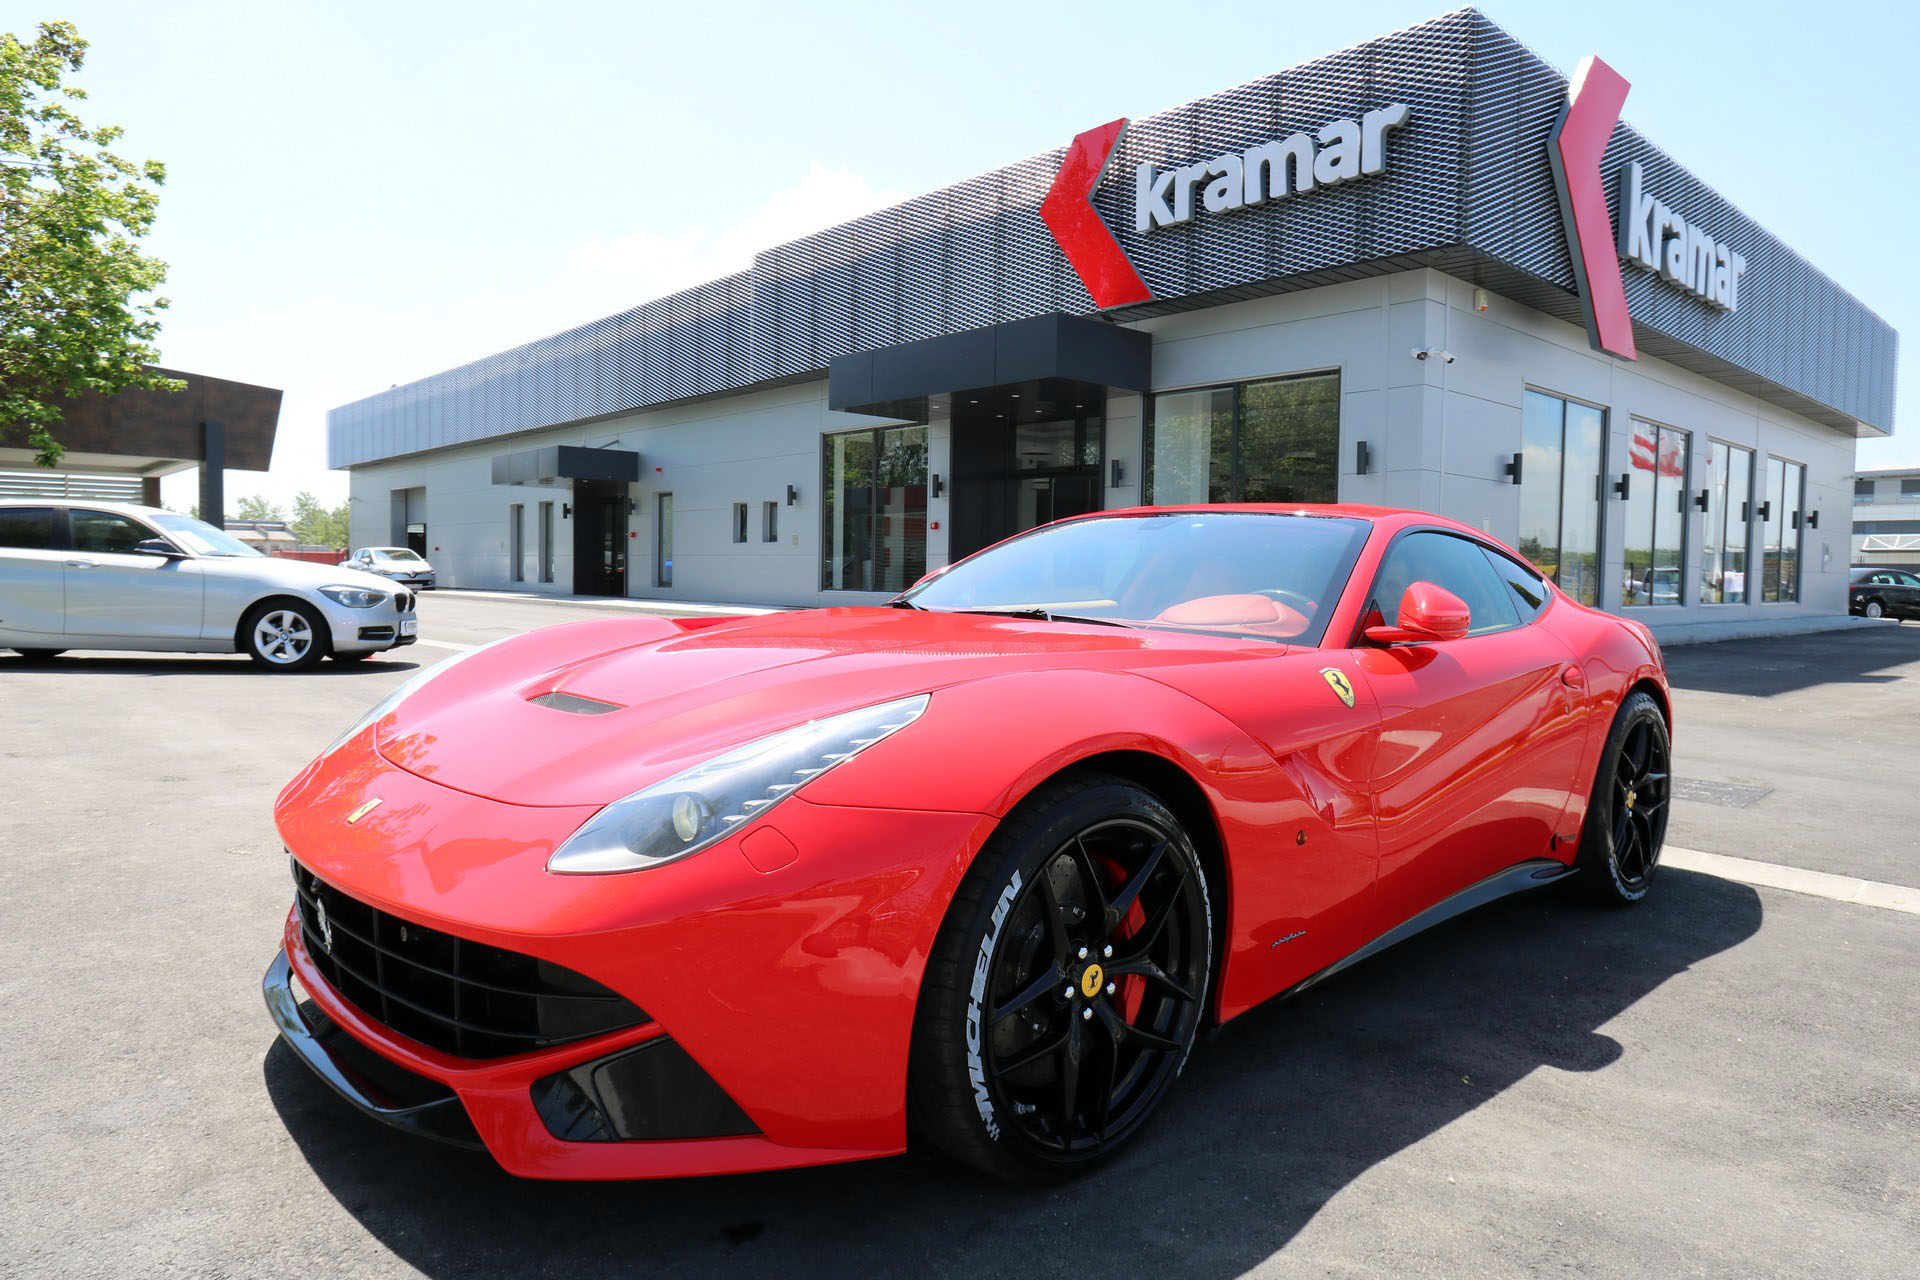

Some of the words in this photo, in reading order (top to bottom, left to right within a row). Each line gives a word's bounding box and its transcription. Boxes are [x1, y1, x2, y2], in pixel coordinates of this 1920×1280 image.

[1135, 103, 1411, 233] kramar
[1625, 163, 1747, 314] kramar
[966, 869, 1023, 1122] MICHELIN
